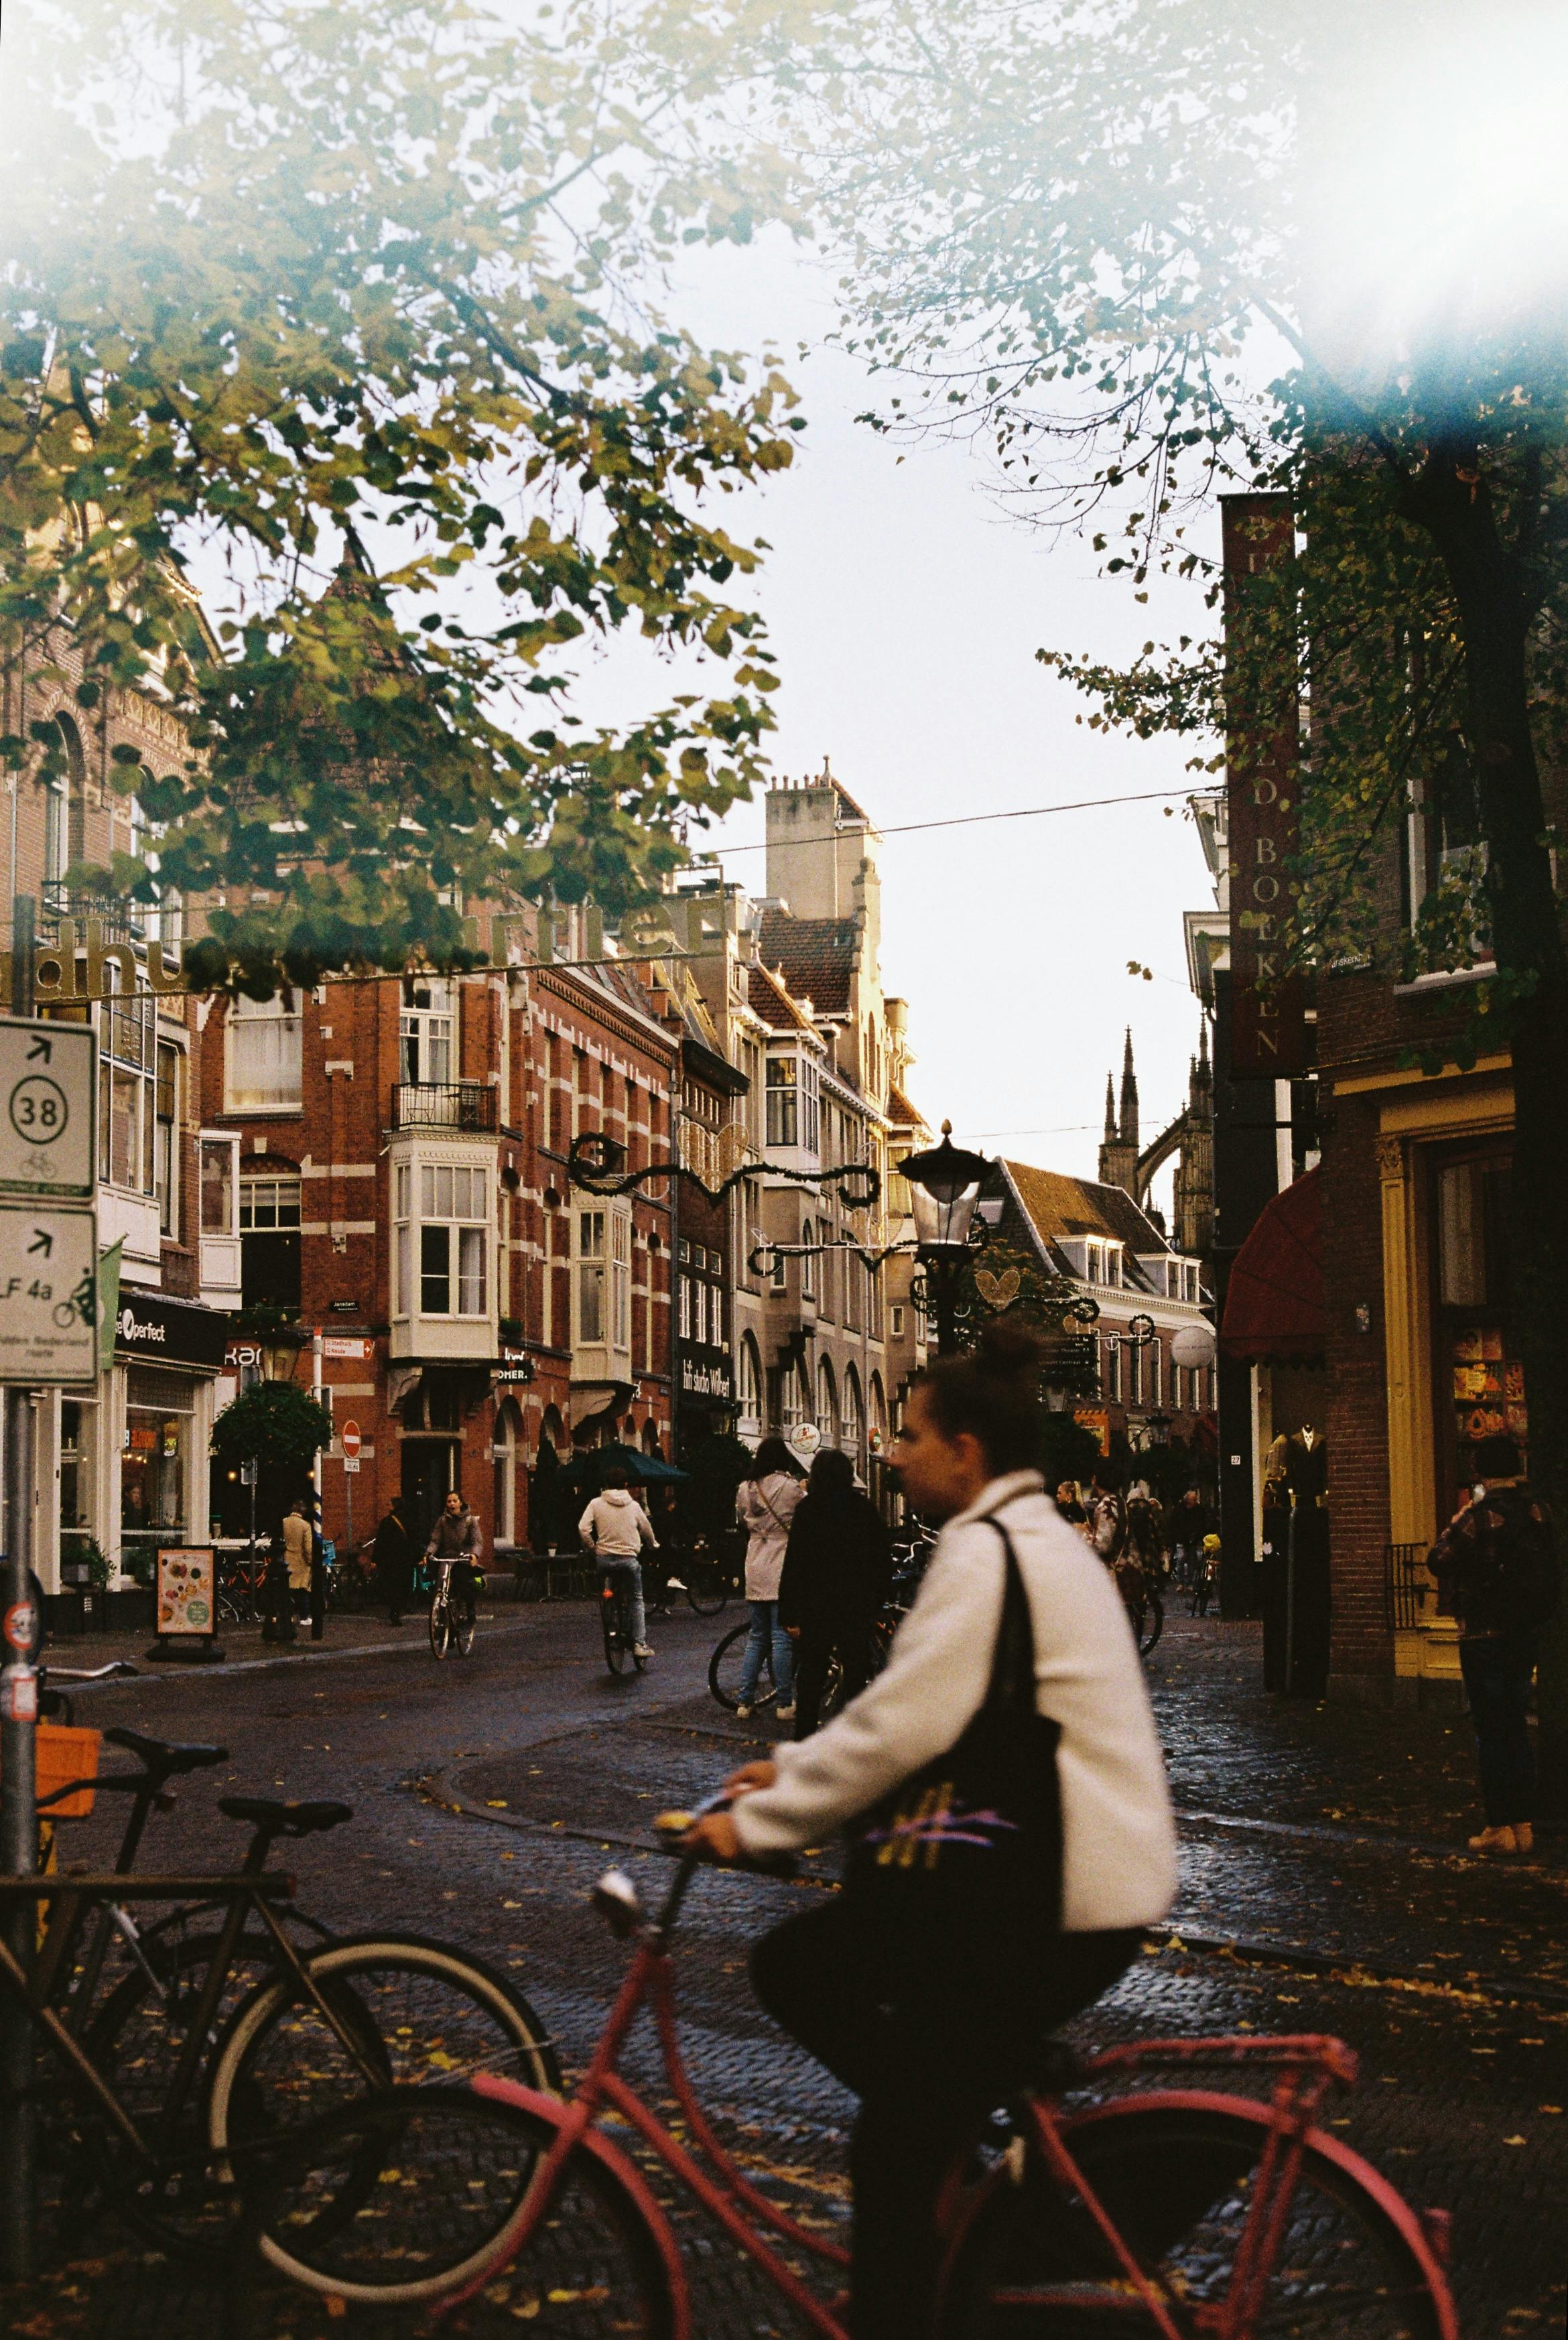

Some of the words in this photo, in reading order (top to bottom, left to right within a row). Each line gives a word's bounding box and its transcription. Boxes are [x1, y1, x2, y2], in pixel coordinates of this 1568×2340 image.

[20, 1096, 57, 1126] 38
[27, 1279, 53, 1301] 4a
[133, 1321, 166, 1343] perfect
